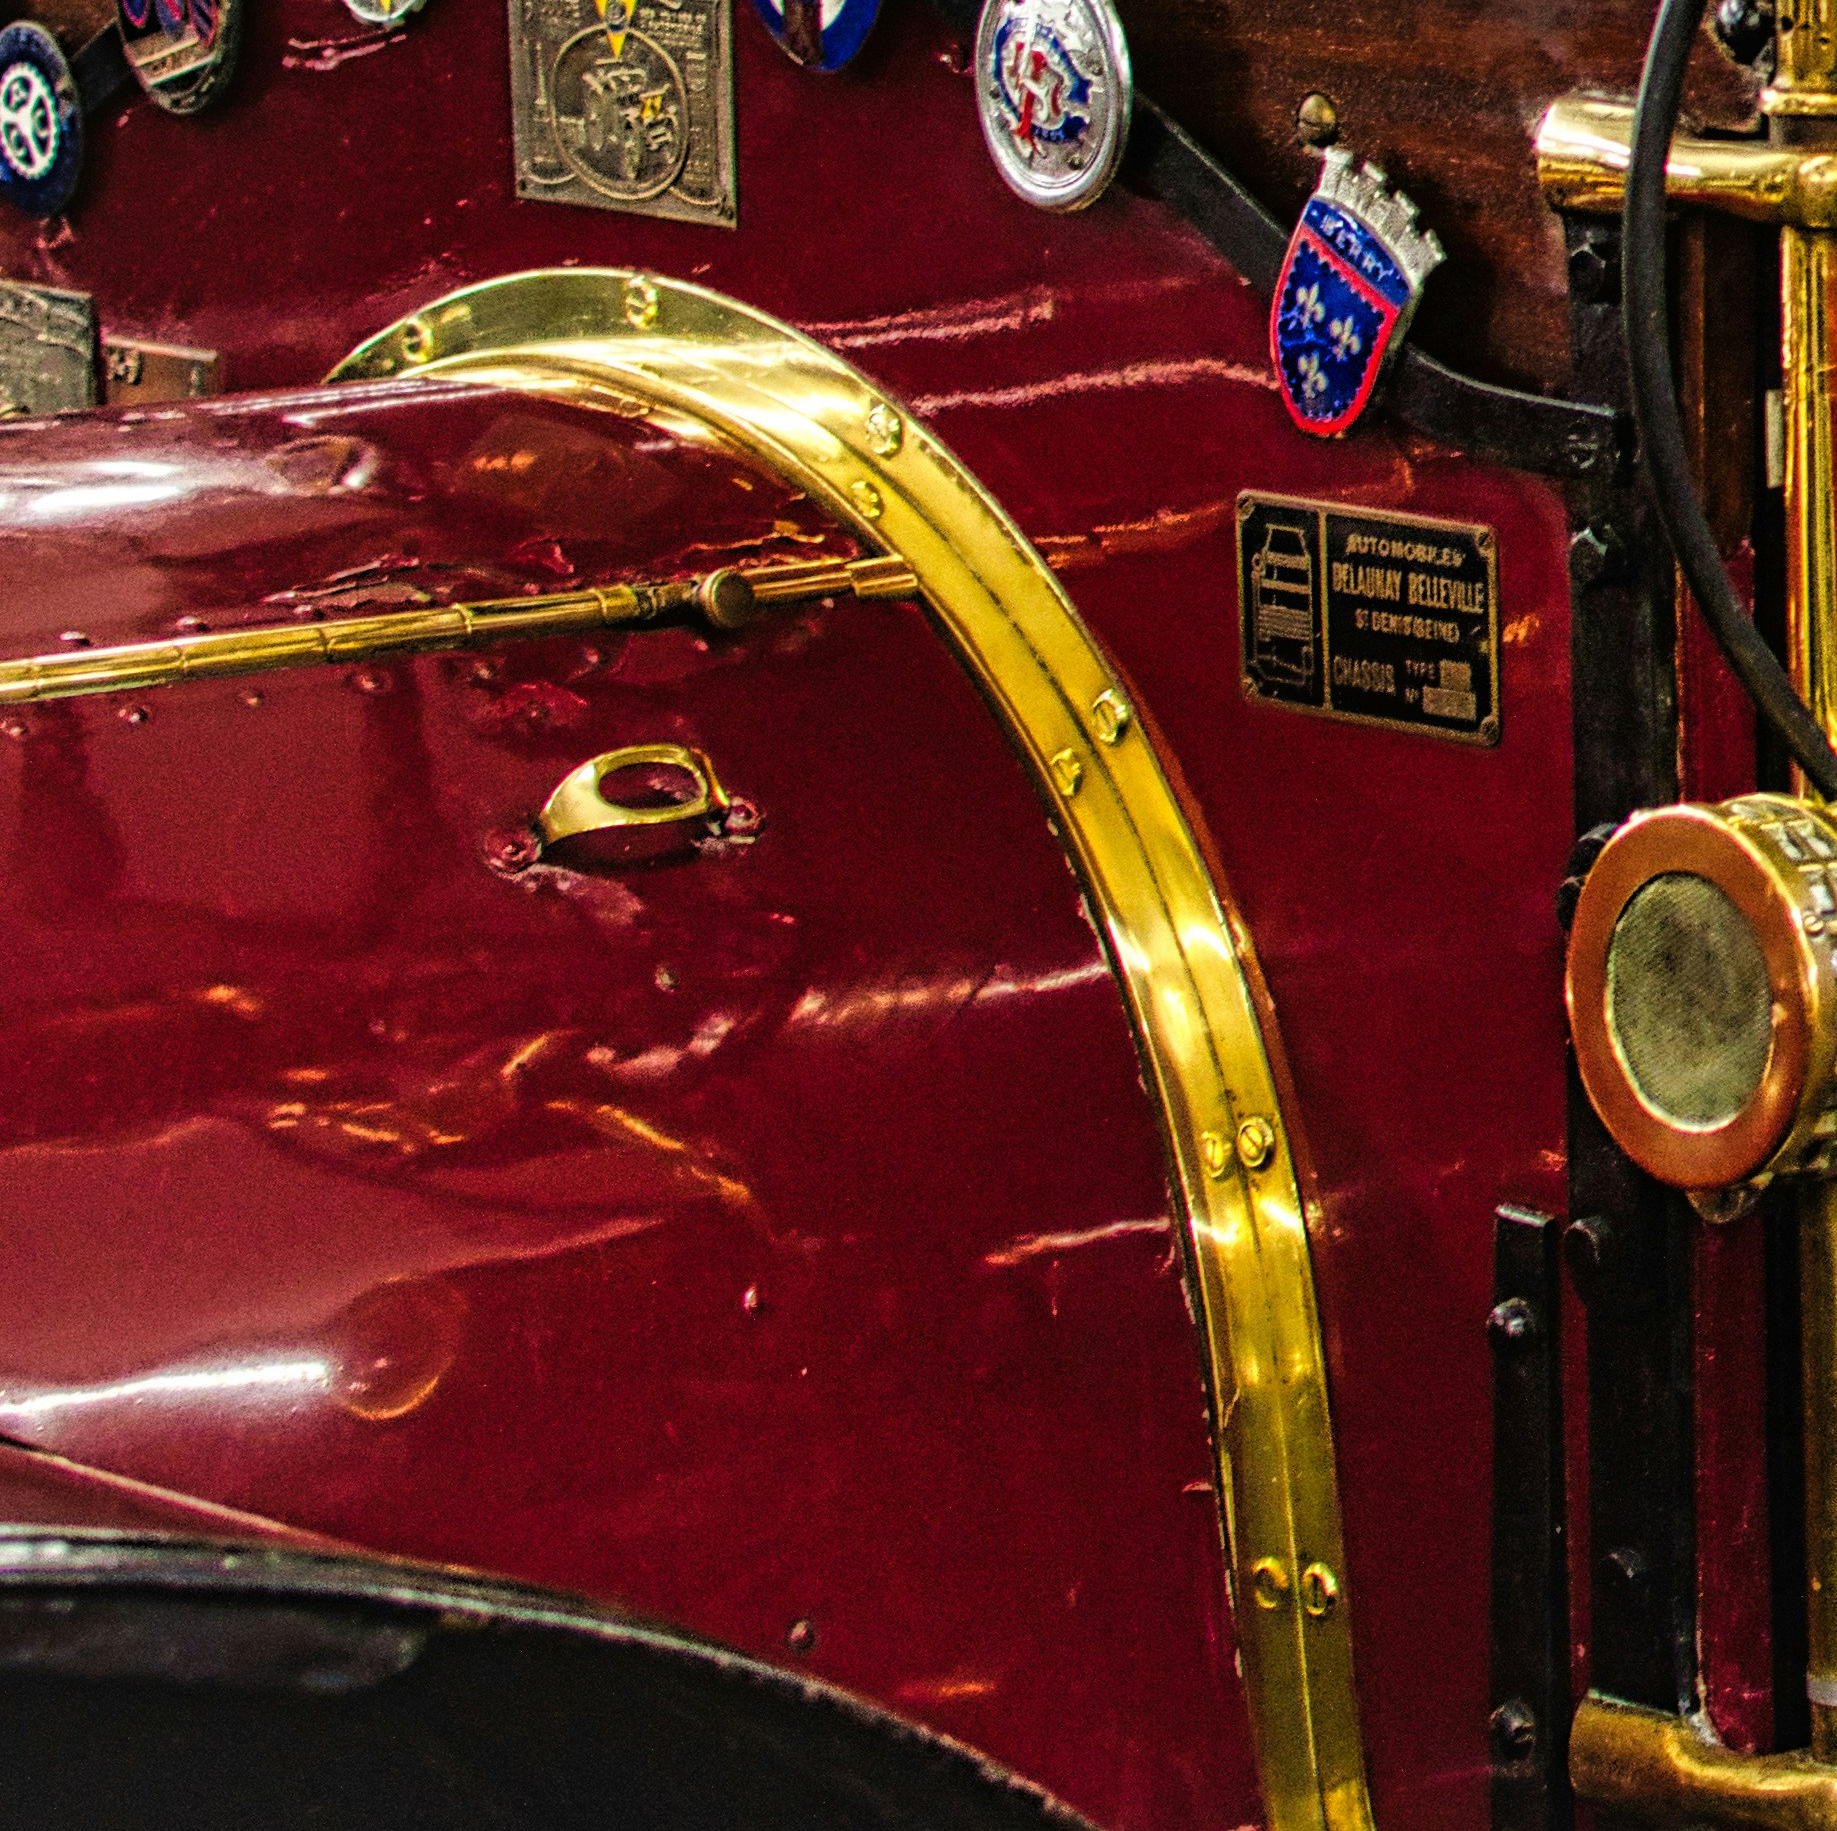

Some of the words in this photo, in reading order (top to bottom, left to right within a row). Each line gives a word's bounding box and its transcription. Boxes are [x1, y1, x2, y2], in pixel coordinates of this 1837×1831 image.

[1319, 214, 1395, 283] BERRY
[1345, 533, 1467, 568] AUTOMOBILES
[1332, 562, 1402, 602] DELAUNAY
[1407, 571, 1485, 615] BELLEVILLE
[1332, 654, 1397, 696] CHASSIS
[1405, 659, 1436, 681] TYPE
